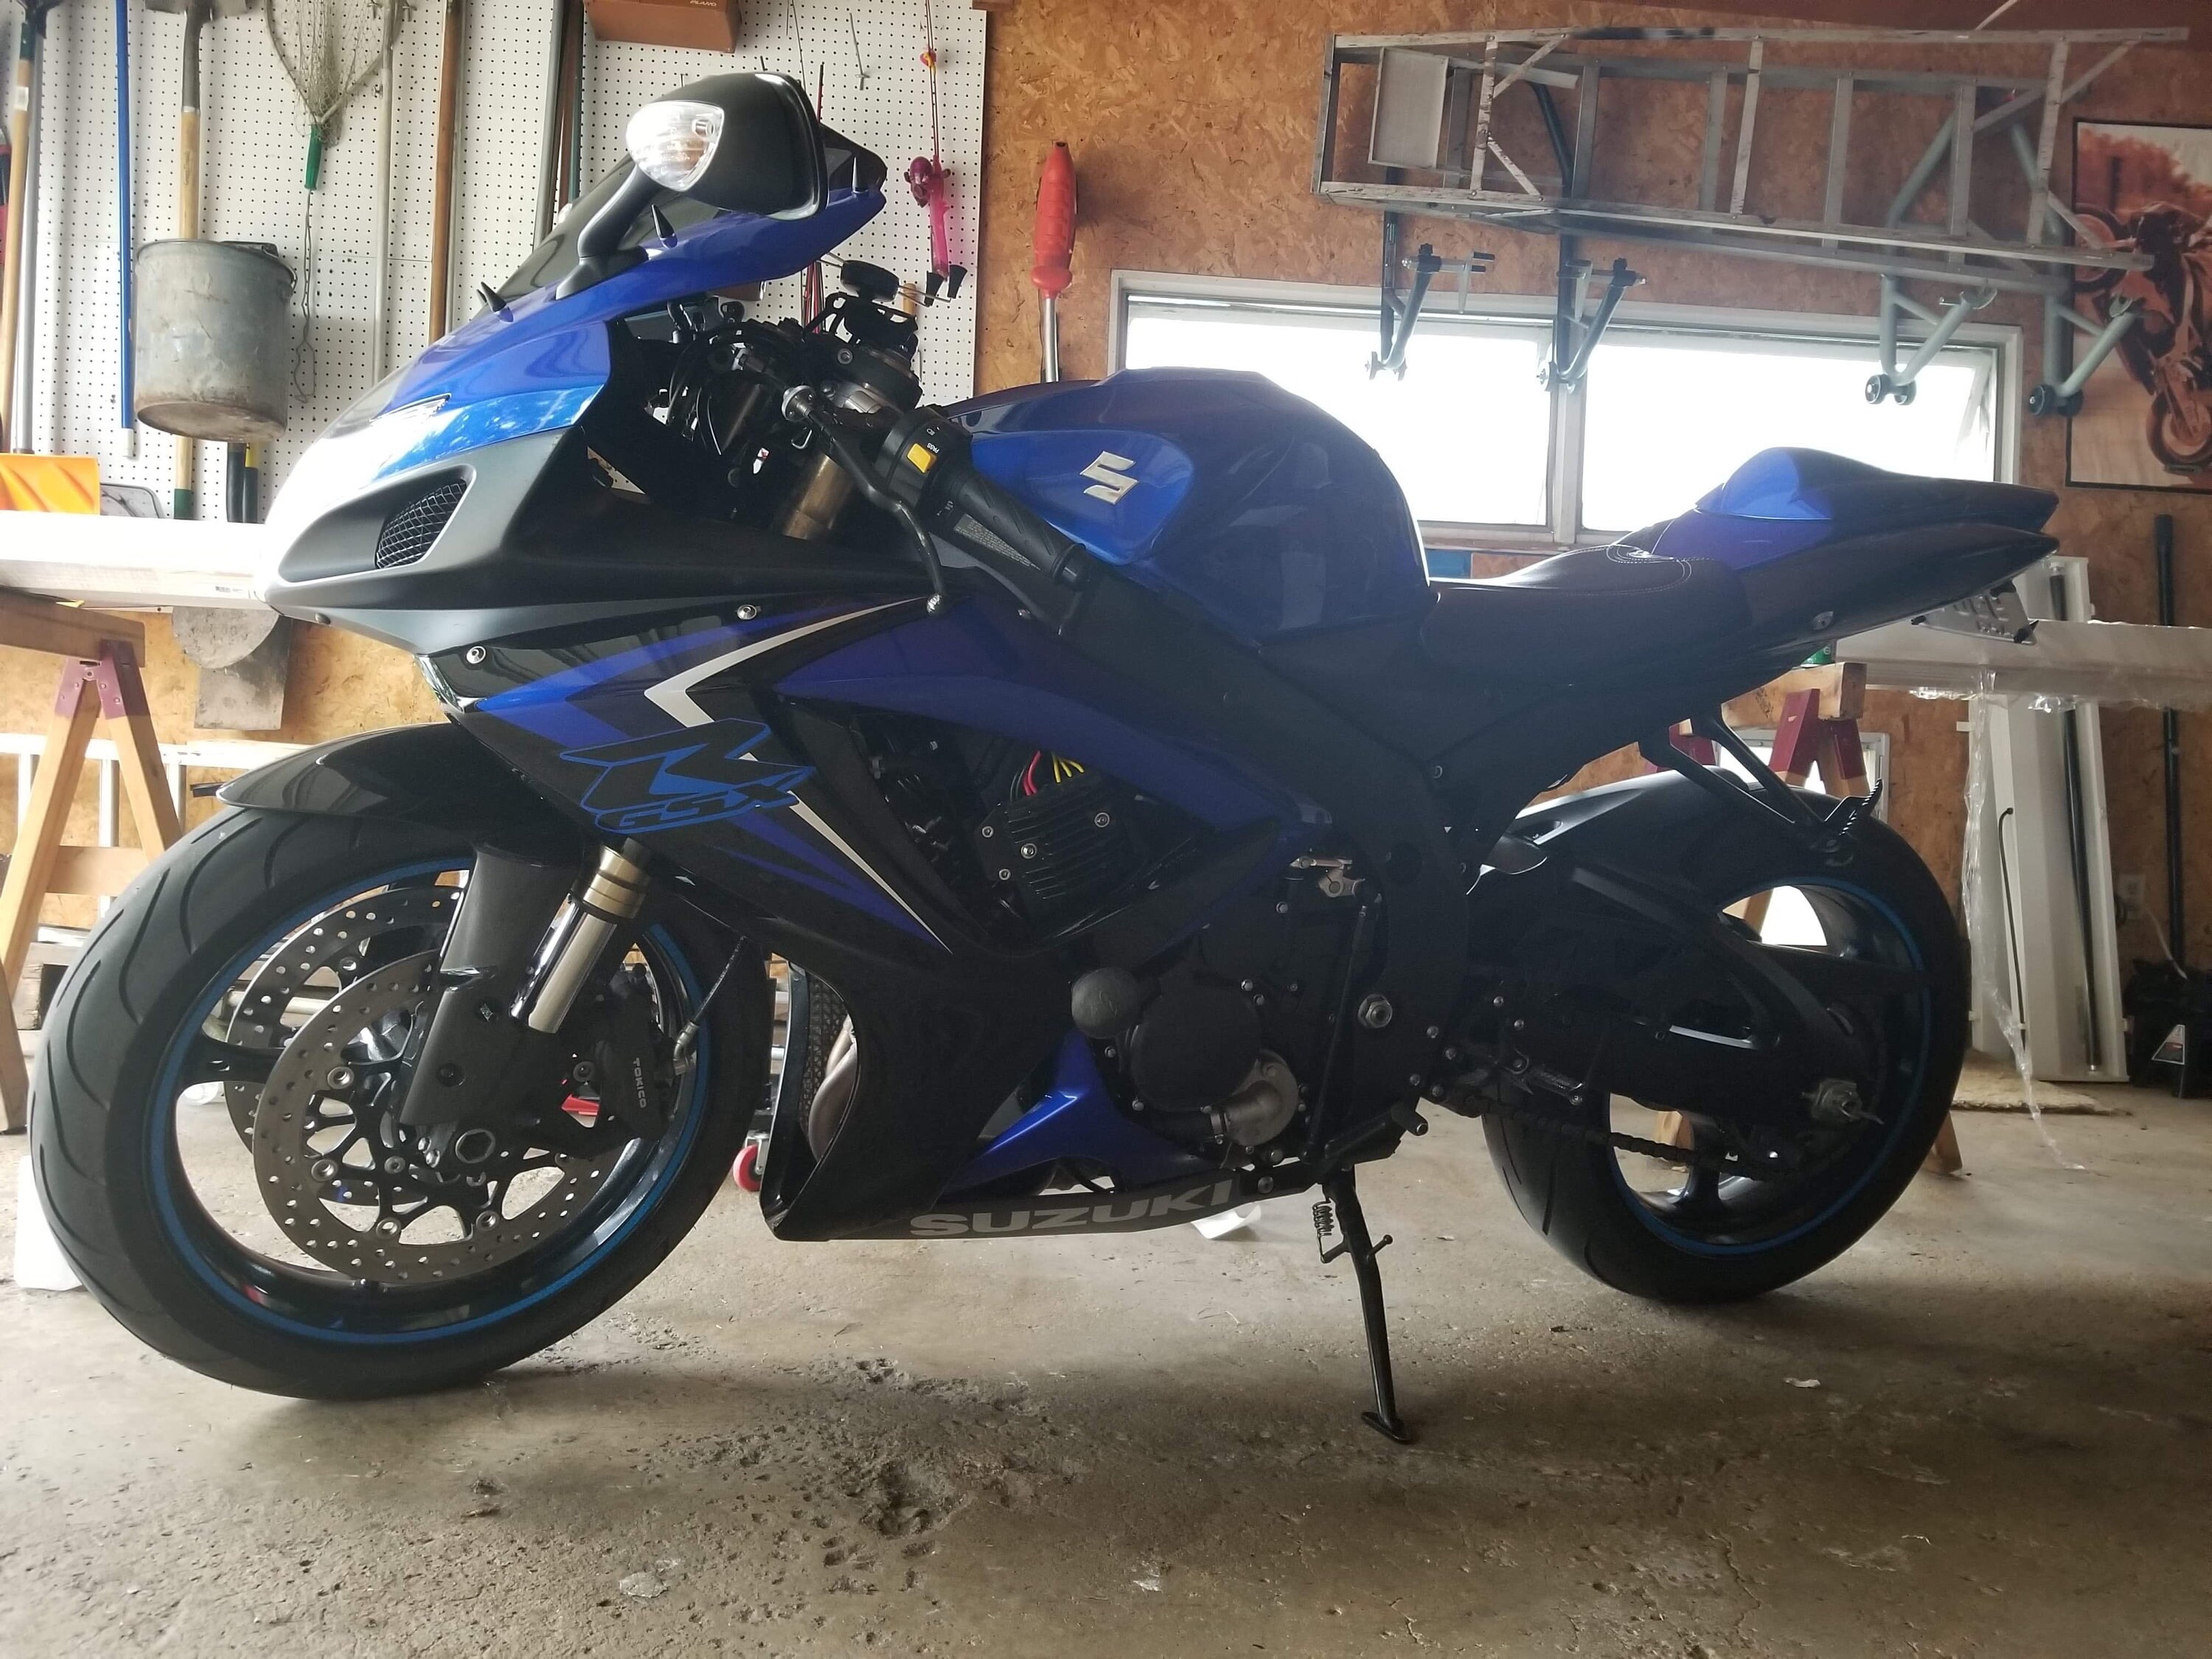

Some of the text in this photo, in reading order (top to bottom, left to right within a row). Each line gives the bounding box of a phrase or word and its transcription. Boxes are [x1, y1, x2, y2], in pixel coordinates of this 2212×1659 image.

[927, 442, 940, 453] PASS
[633, 1057, 647, 1109] TOKICO
[909, 1178, 1234, 1237] SUZUKI
